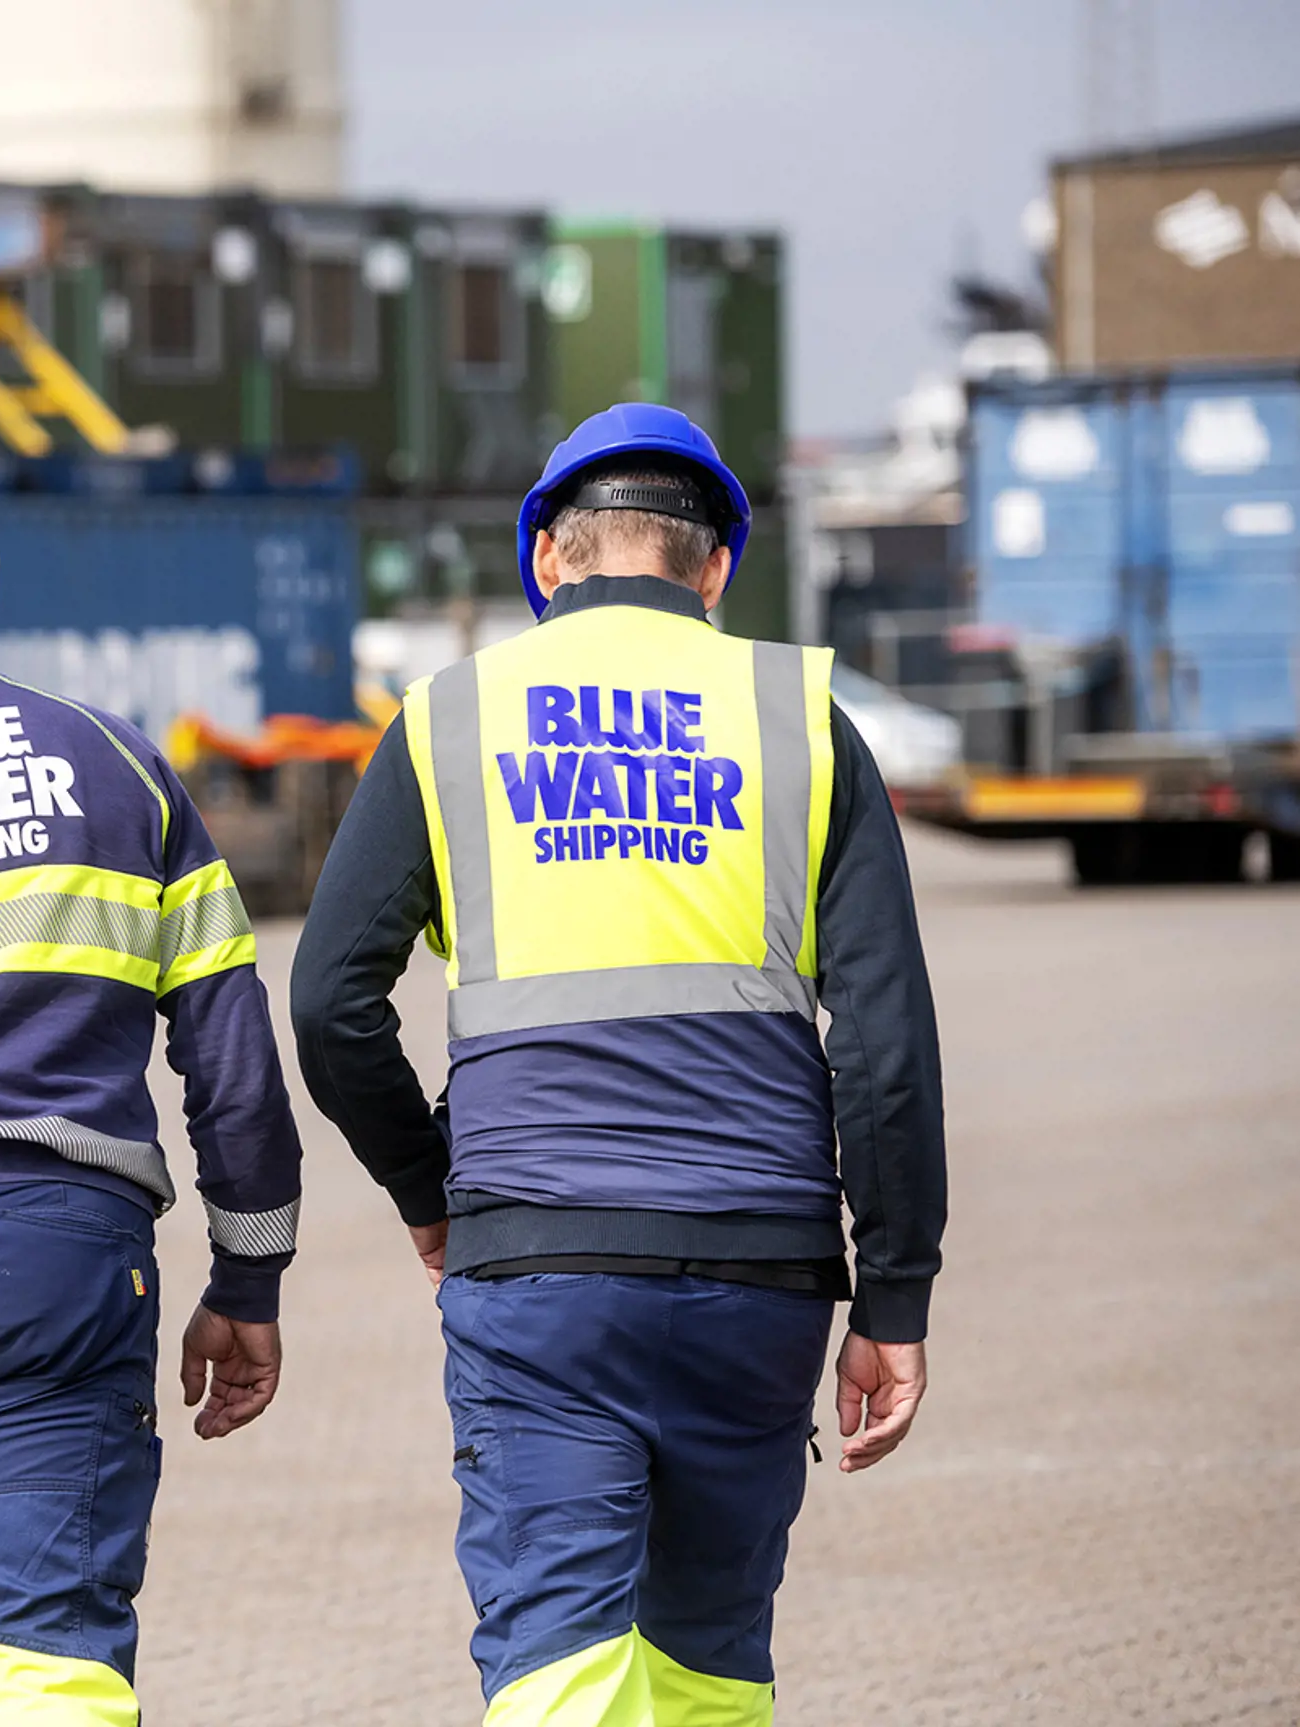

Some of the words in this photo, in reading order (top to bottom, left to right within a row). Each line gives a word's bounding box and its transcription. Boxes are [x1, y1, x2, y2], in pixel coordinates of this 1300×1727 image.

[526, 685, 705, 753] BLUE
[496, 750, 745, 830] WATER
[534, 824, 708, 865] SHIPPING
